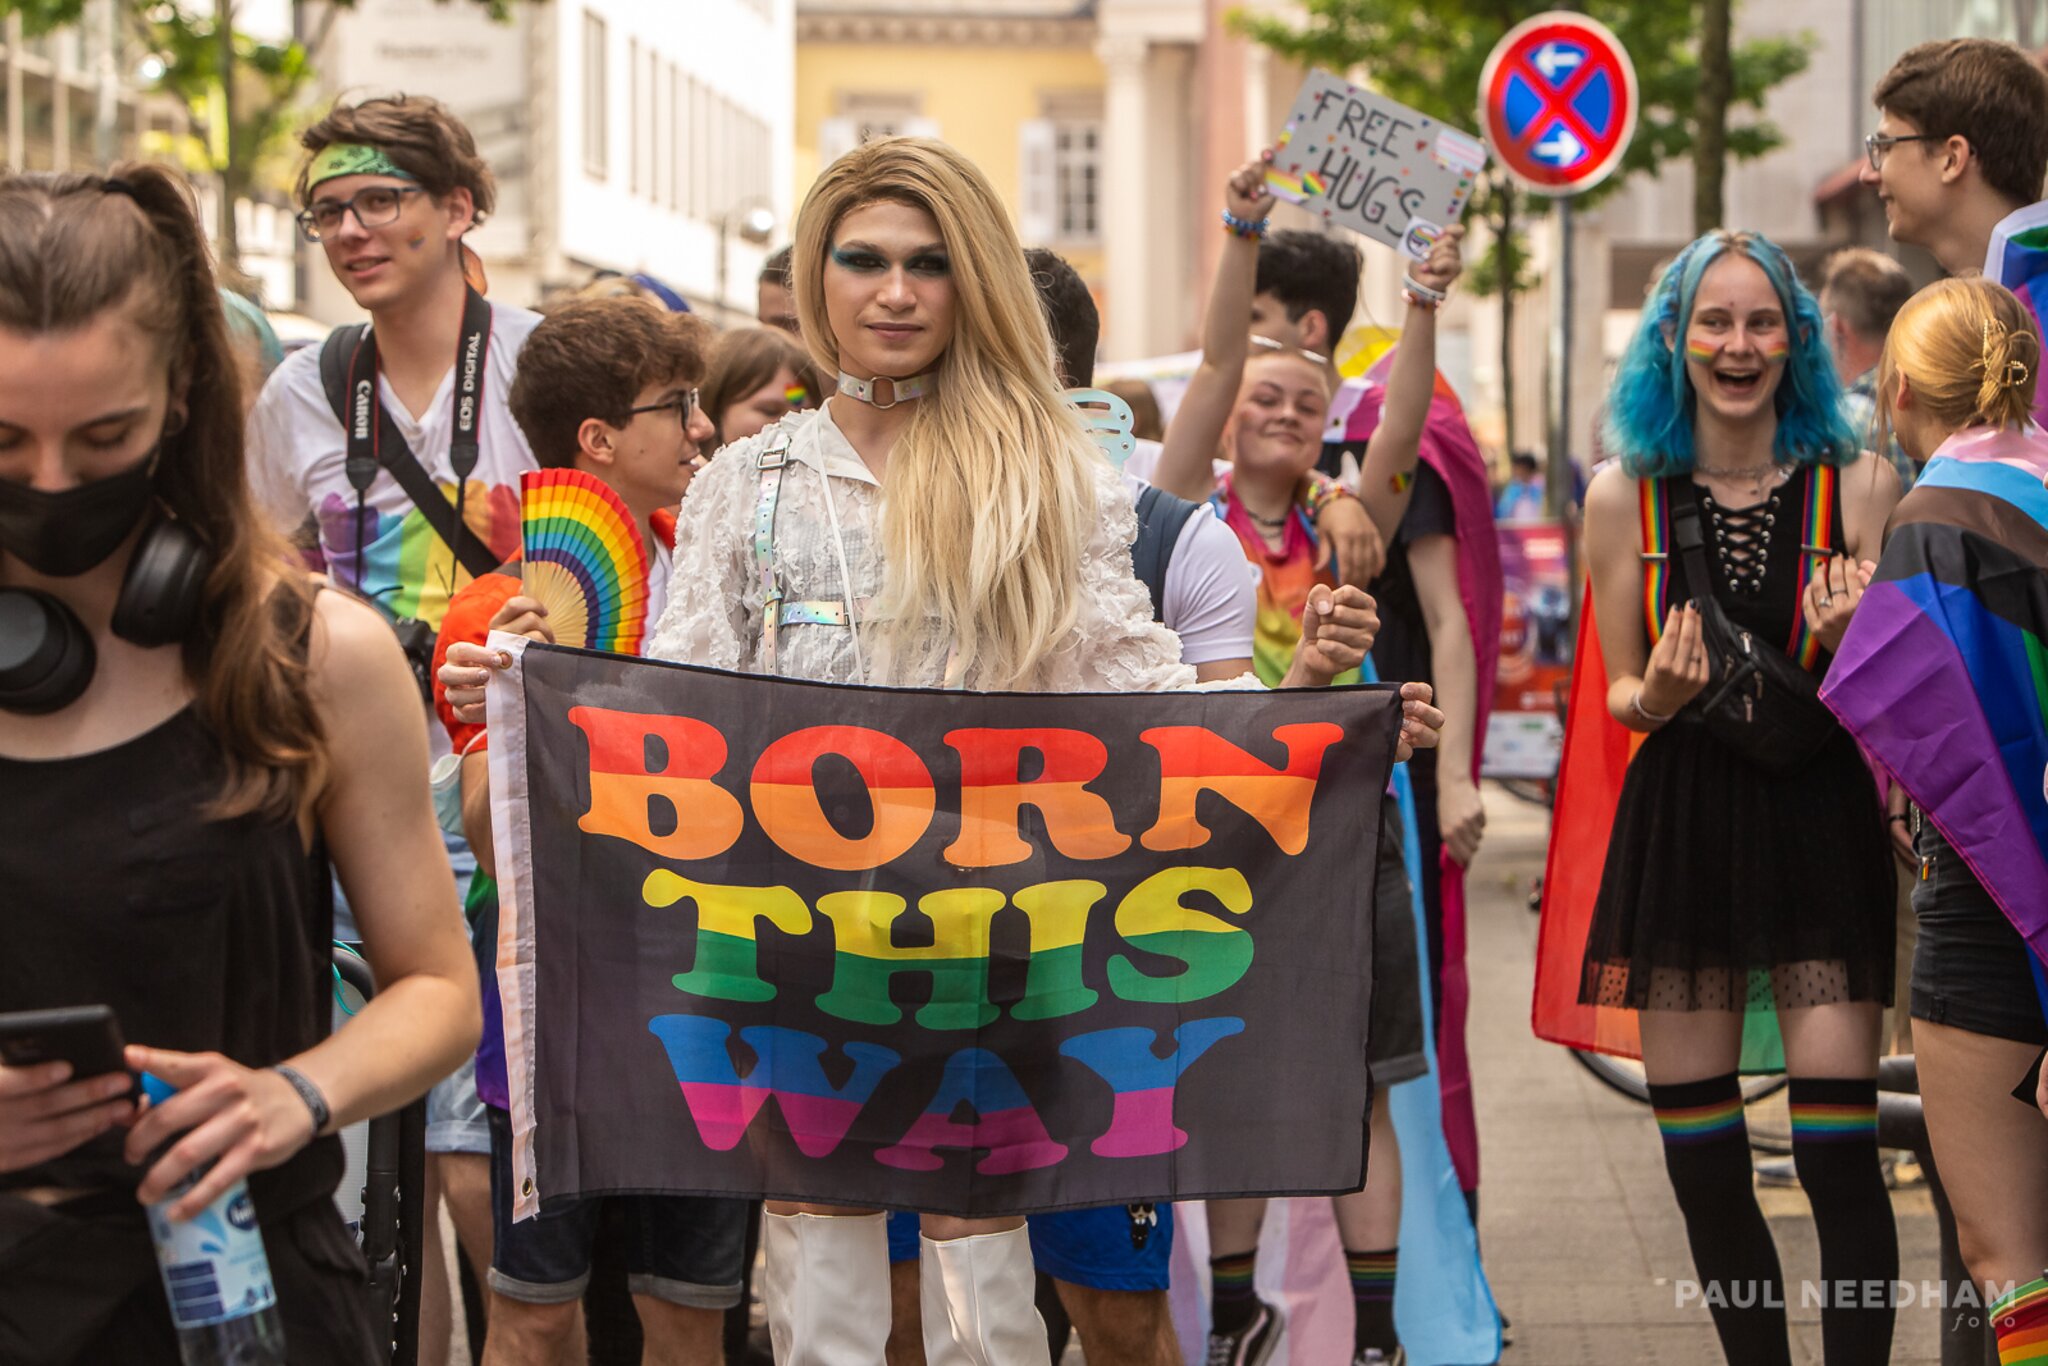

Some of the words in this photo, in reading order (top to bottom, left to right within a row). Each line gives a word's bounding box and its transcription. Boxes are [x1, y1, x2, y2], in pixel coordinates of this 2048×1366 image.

[1312, 90, 1415, 159] FREE
[1319, 148, 1426, 238] HUGS
[463, 332, 481, 392] DIGITAL
[355, 380, 372, 439] Canon
[459, 396, 474, 432] EOS
[568, 705, 1344, 870] BORN
[642, 866, 1254, 1030] THIS
[648, 1015, 1245, 1174] WAY
